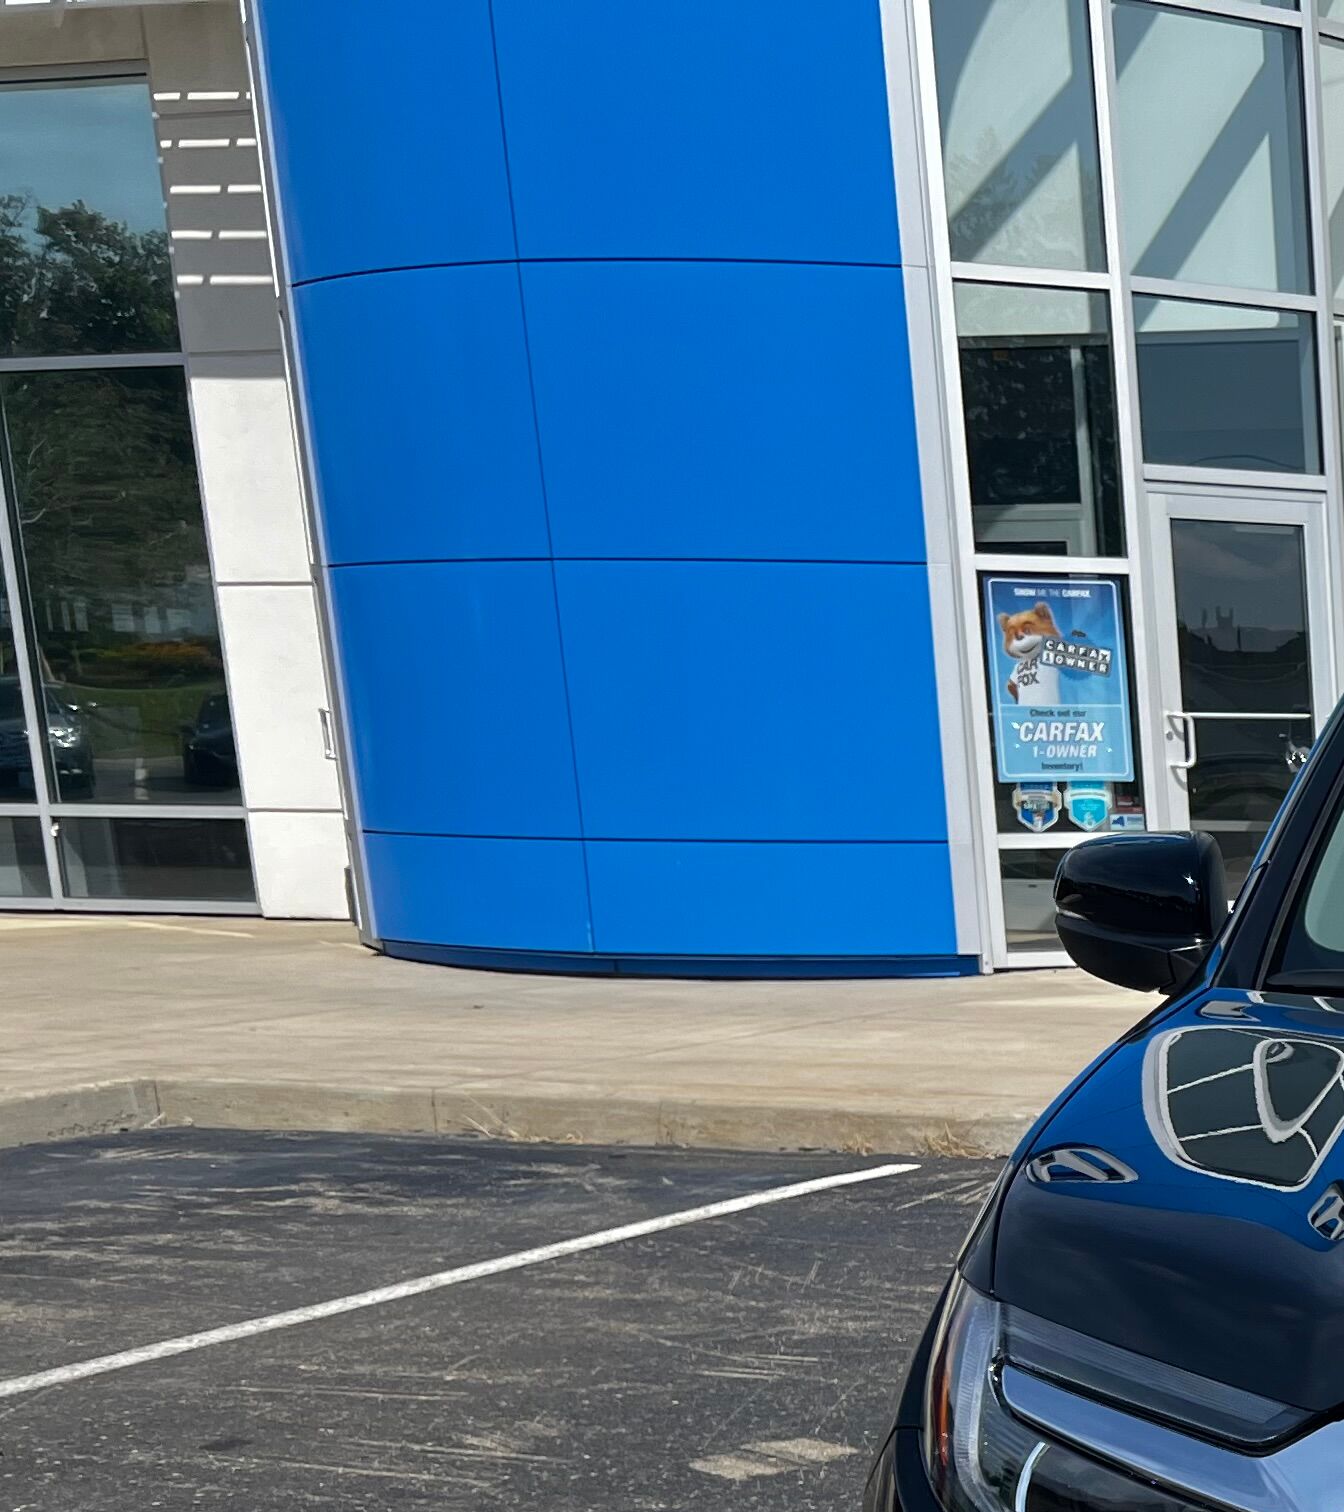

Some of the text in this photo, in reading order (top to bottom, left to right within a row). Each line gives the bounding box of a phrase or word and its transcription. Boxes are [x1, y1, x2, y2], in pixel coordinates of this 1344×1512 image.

[1045, 640, 1111, 662] CARFAX
[1019, 721, 1105, 742] CARFAX
[1033, 745, 1098, 758] 1-OWNER
